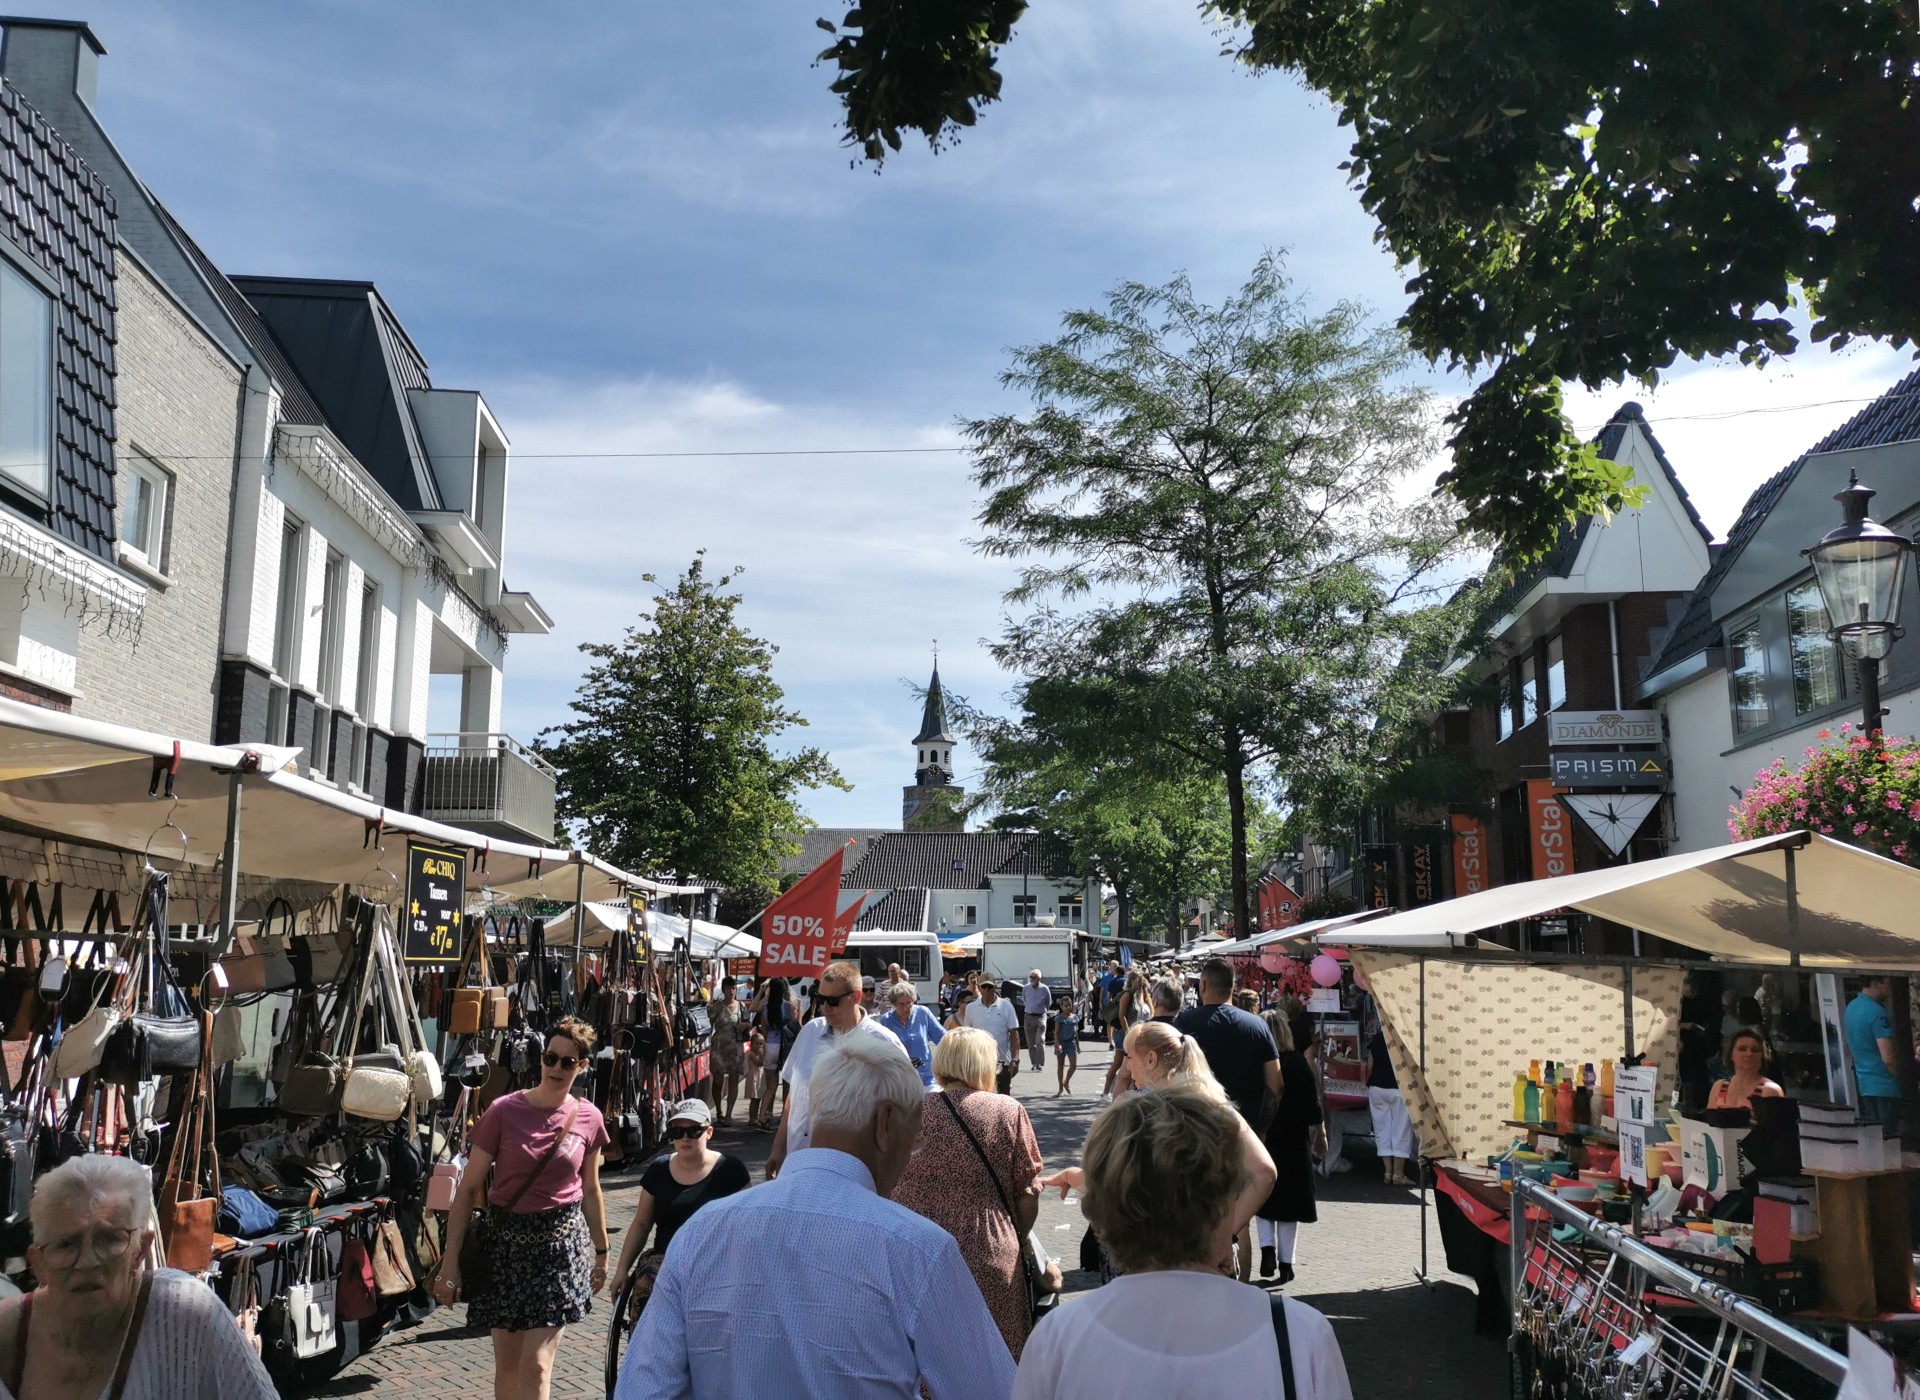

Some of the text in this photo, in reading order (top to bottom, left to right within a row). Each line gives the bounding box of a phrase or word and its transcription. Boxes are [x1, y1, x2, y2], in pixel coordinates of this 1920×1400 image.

[1557, 724, 1656, 739] DIAMONDE
[1556, 759, 1662, 773] PRISMA
[1536, 798, 1566, 879] erStal
[437, 860, 456, 880] CHIQ
[1414, 844, 1428, 900] OKAY
[1459, 827, 1482, 895] erStal
[1373, 862, 1385, 909] OKY
[771, 914, 825, 938] 50%
[765, 942, 827, 967] SALE
[831, 938, 846, 949] LE
